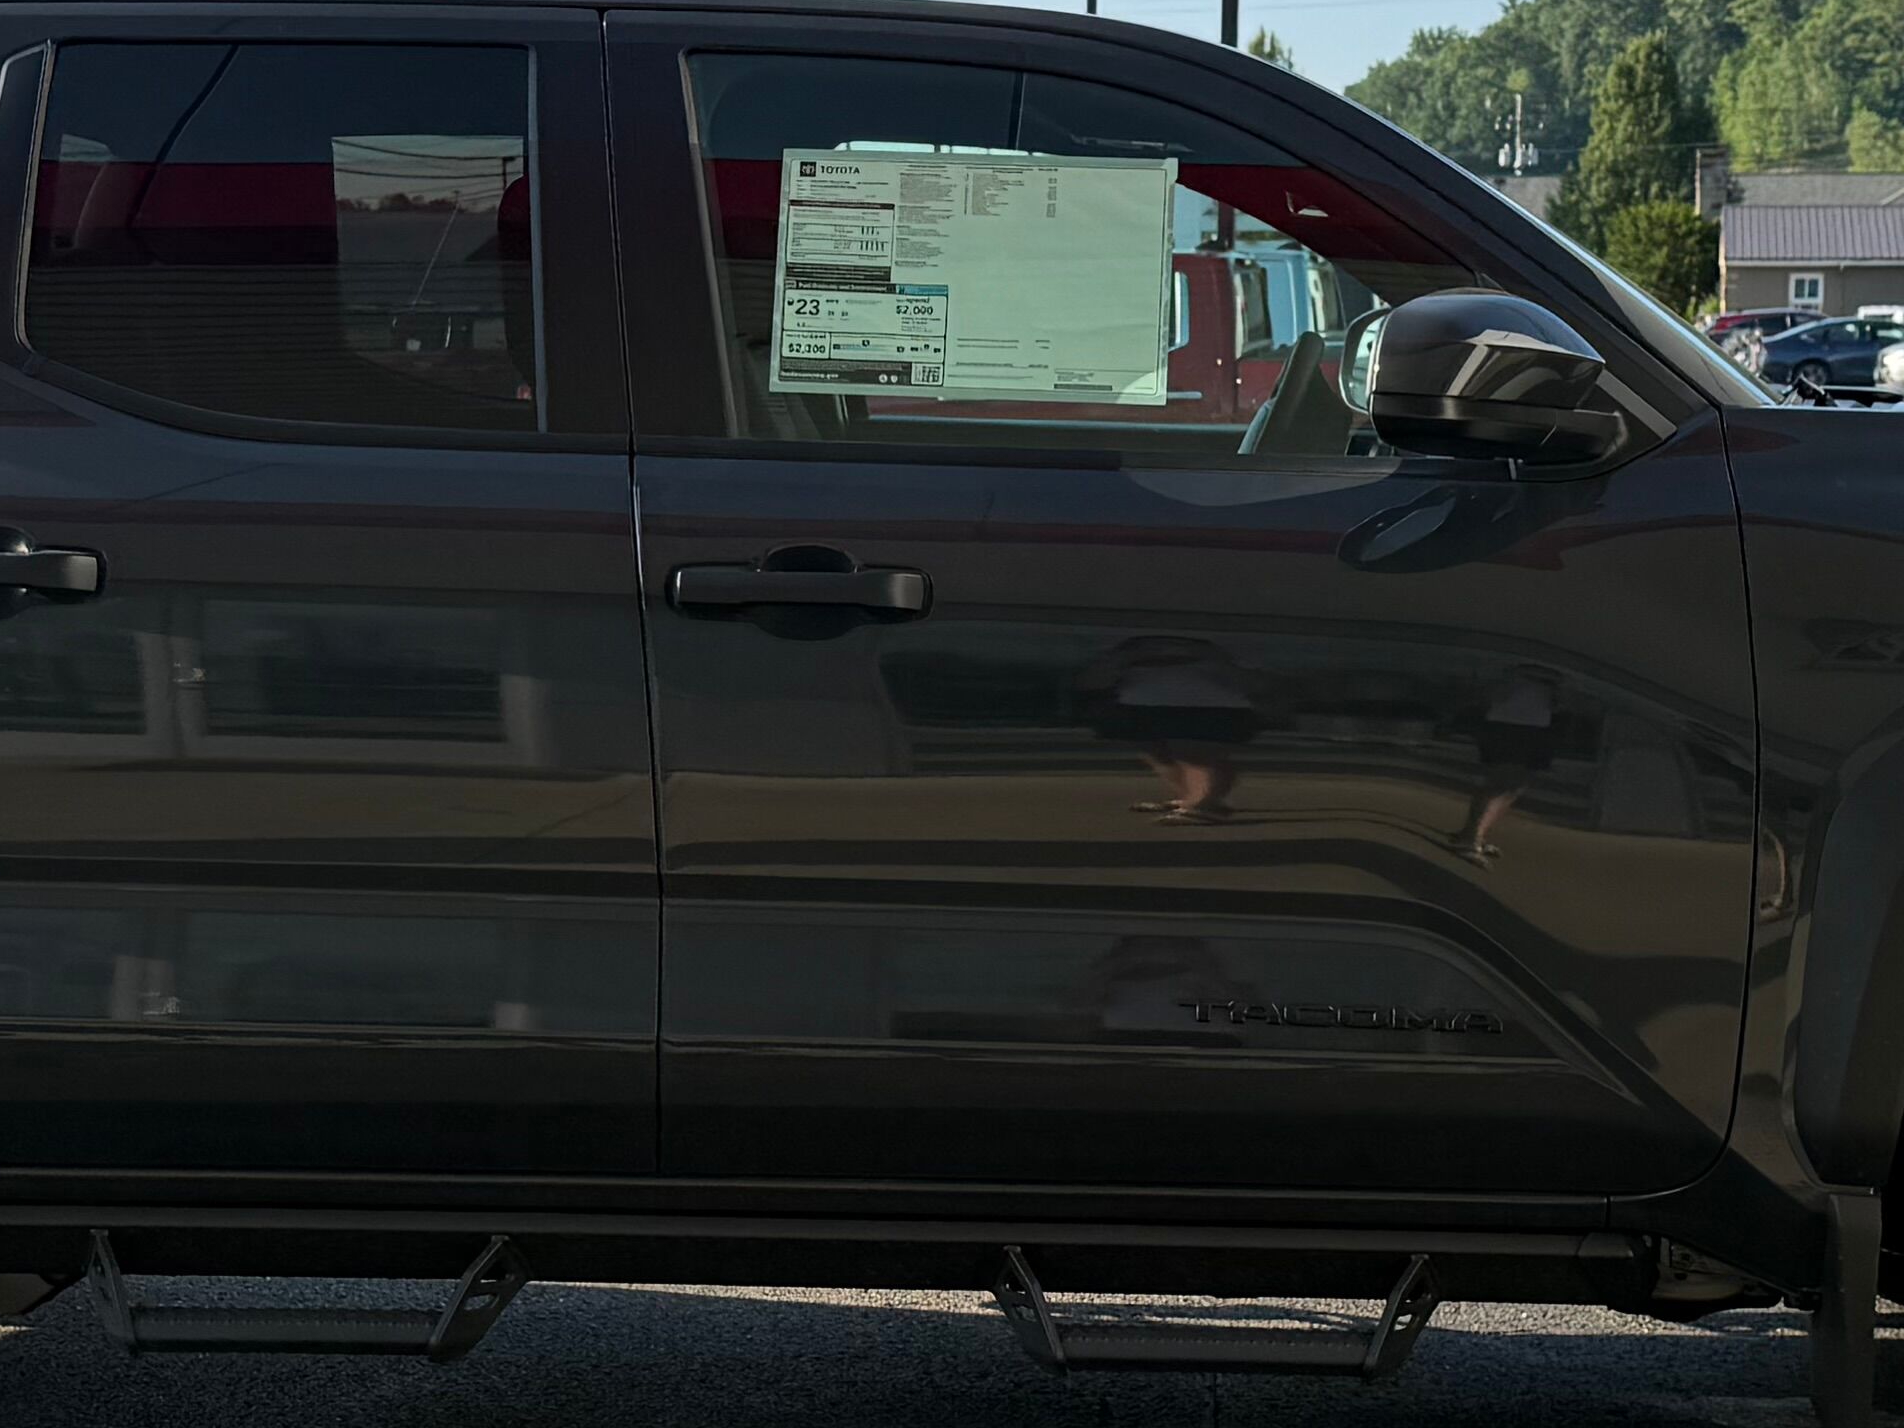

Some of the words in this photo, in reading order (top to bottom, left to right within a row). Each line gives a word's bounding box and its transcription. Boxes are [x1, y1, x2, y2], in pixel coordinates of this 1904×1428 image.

[820, 164, 861, 175] TOYOTA
[795, 298, 821, 316] 23
[1179, 1000, 1503, 1033] TACOMA
